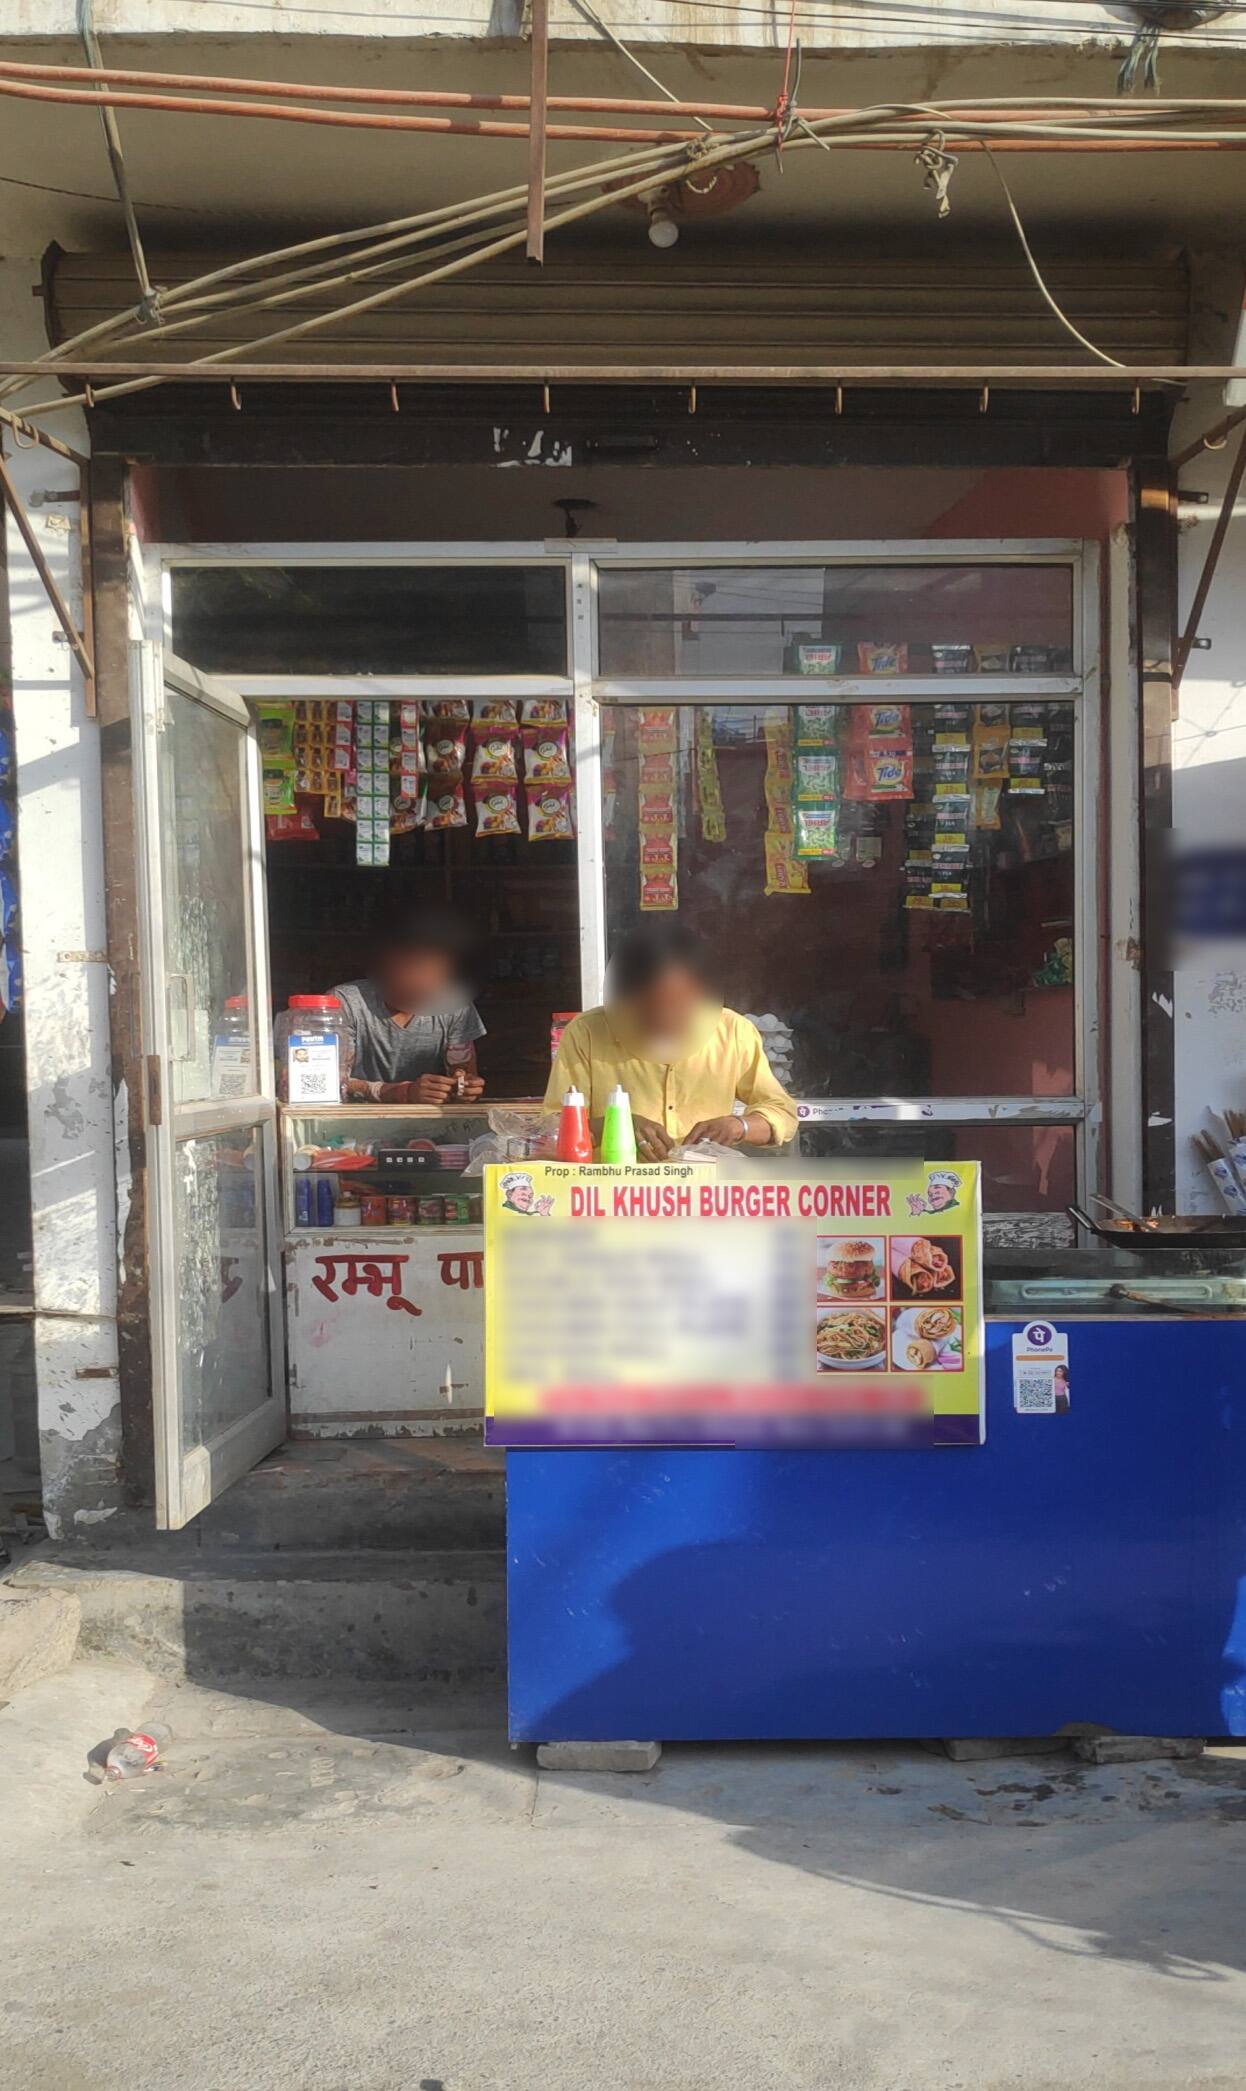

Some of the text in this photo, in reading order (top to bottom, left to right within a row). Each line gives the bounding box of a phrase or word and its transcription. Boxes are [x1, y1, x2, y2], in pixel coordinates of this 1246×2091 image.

[544, 1166, 570, 1178] Prop
[578, 1166, 622, 1176] Rambhu
[625, 1166, 660, 1176] Prasad
[663, 1166, 693, 1178] Singh
[571, 1185, 891, 1217] DIL KHUSH BURGER CORNER
